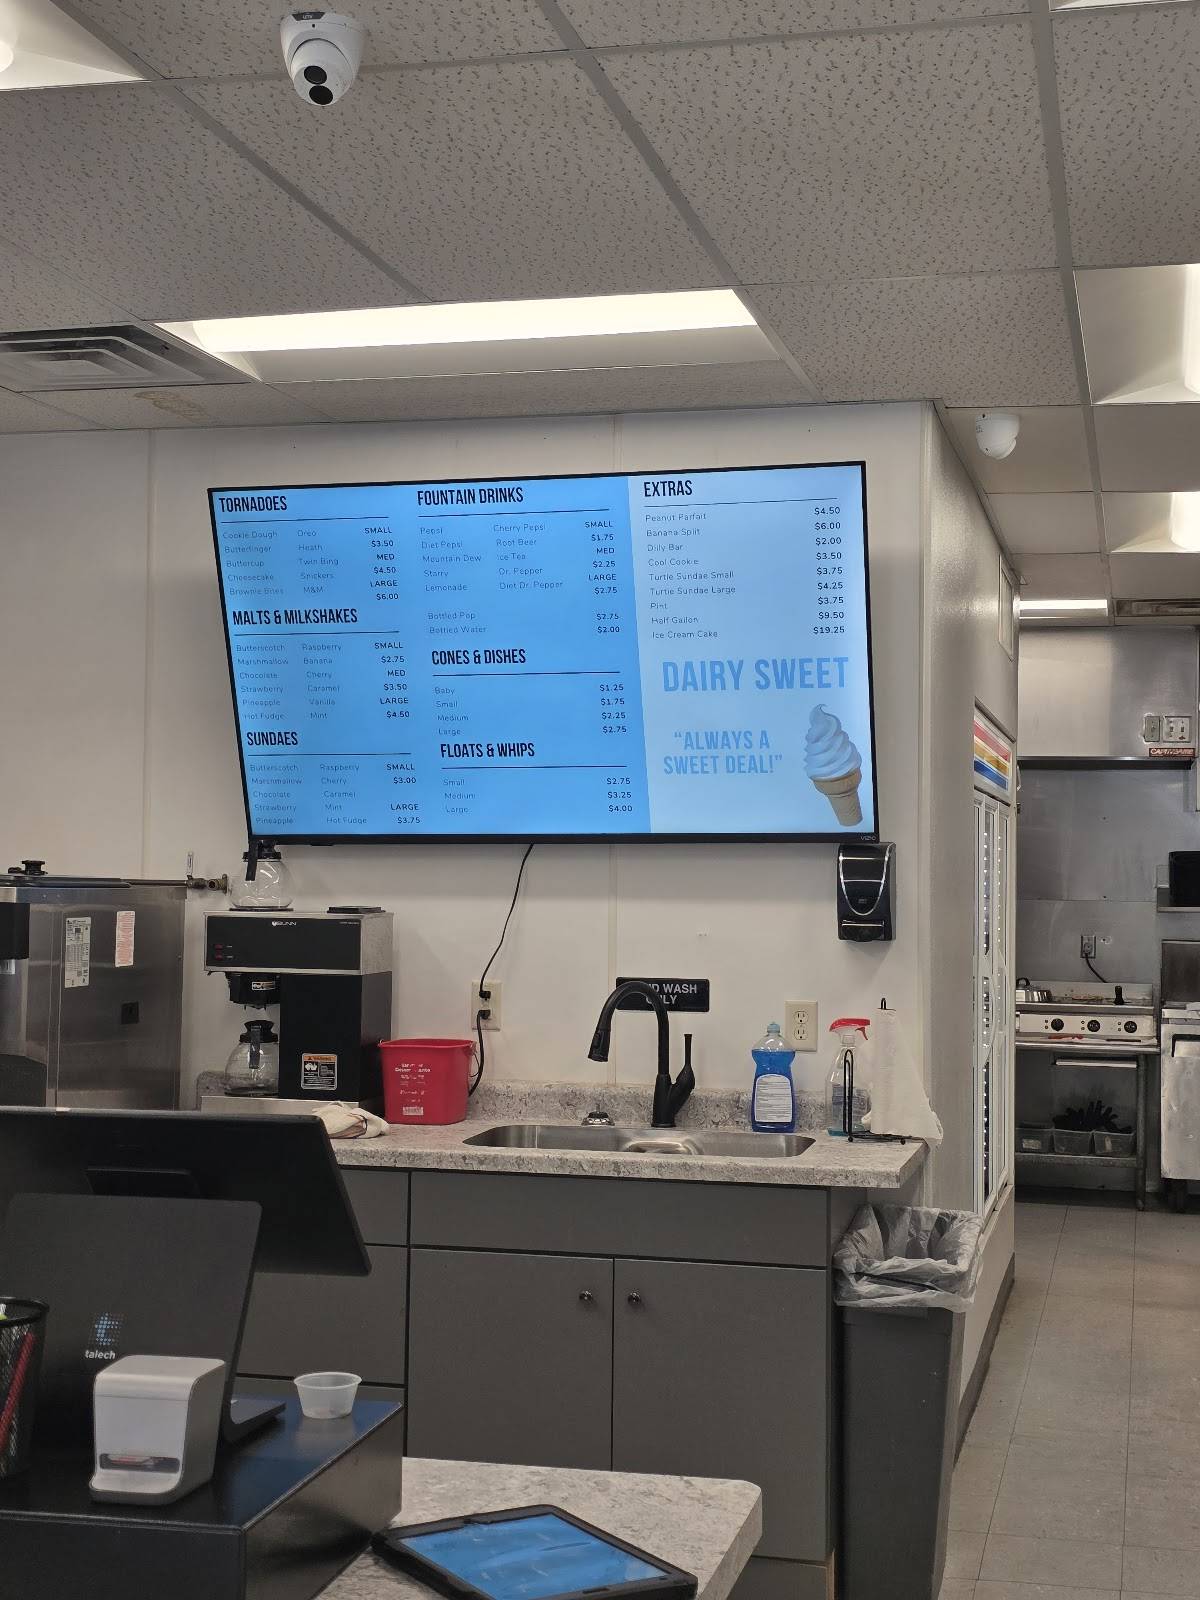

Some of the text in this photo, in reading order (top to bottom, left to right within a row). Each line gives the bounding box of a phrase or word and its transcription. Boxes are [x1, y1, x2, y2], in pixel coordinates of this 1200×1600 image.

[644, 480, 693, 498] EXTRAS
[417, 486, 524, 506] FOUNTAIN DRINKS
[218, 495, 288, 513] TORNADOES
[813, 506, 841, 516] $4.50
[645, 514, 675, 523] Peanut
[584, 521, 613, 529] SMALL
[814, 521, 841, 531] $6.00
[296, 529, 318, 538] Oreo
[363, 526, 393, 535] SMALL
[646, 528, 701, 538] Banana Split
[591, 533, 614, 542] $1.75
[815, 537, 842, 546] $2.00
[370, 539, 395, 548] $3.50
[647, 543, 683, 553] Dilly Bar
[375, 553, 396, 561] MED
[816, 551, 842, 561] $3.50
[592, 560, 616, 569] $2.25
[648, 557, 699, 567] Cool Cookie
[373, 566, 397, 575] $4.50
[423, 569, 449, 579] Starry
[816, 566, 844, 576] $3.75
[588, 573, 617, 581] LARGE
[648, 570, 735, 582] Turtle Sundae Small
[369, 579, 399, 588] LARGE
[424, 583, 468, 592] Lemonade
[817, 581, 844, 591] $4.25
[302, 586, 325, 594] M&M
[594, 586, 618, 595] $2.75
[649, 586, 736, 597] Turtle Sundae Large
[375, 592, 400, 601] $6.00
[817, 596, 845, 605] $3.75
[650, 602, 668, 611] Pint
[232, 608, 358, 626] MALTS & MILKSHAKES
[596, 612, 620, 621] $2.75
[818, 611, 845, 620] $9.50
[651, 616, 699, 625] Half Gallon
[597, 625, 620, 634] $2.00
[813, 626, 845, 635] $19.25
[652, 630, 718, 640] Ice Cream Cake
[301, 643, 342, 652] Raspberry
[373, 642, 404, 650] SMALL
[303, 657, 333, 665] Banana
[380, 655, 405, 664] $2.75
[432, 649, 526, 665] CONES & DISHES
[305, 670, 332, 680] Cherry
[387, 669, 406, 677] MED
[662, 656, 848, 692] DAIRY SWEET
[383, 683, 408, 692] $3.50
[434, 686, 455, 696] Baby
[599, 683, 624, 692] $1.25
[379, 697, 409, 705] LARGE
[435, 700, 458, 709] Small
[600, 697, 625, 706] $1.75
[386, 710, 410, 719] $4.50
[437, 713, 469, 722] Medium
[601, 711, 626, 720] $2.25
[602, 725, 627, 734] $2.75
[246, 731, 298, 746] SUNDAES
[760, 730, 770, 749] A
[440, 742, 535, 758] FLOATS & WHIPS
[319, 763, 360, 772] Raspberry
[386, 763, 416, 771] SMALL
[664, 755, 719, 774] SWEET
[320, 777, 347, 786] Cherry
[393, 776, 418, 785] $3.00
[442, 778, 465, 787] Small
[606, 777, 631, 786] $2.75
[607, 791, 632, 800] $3.25
[390, 803, 420, 811] LARGE
[608, 804, 633, 813] $4.00
[397, 816, 421, 825] $3.75
[663, 984, 697, 993] WASH
[85, 1350, 116, 1359] talech
